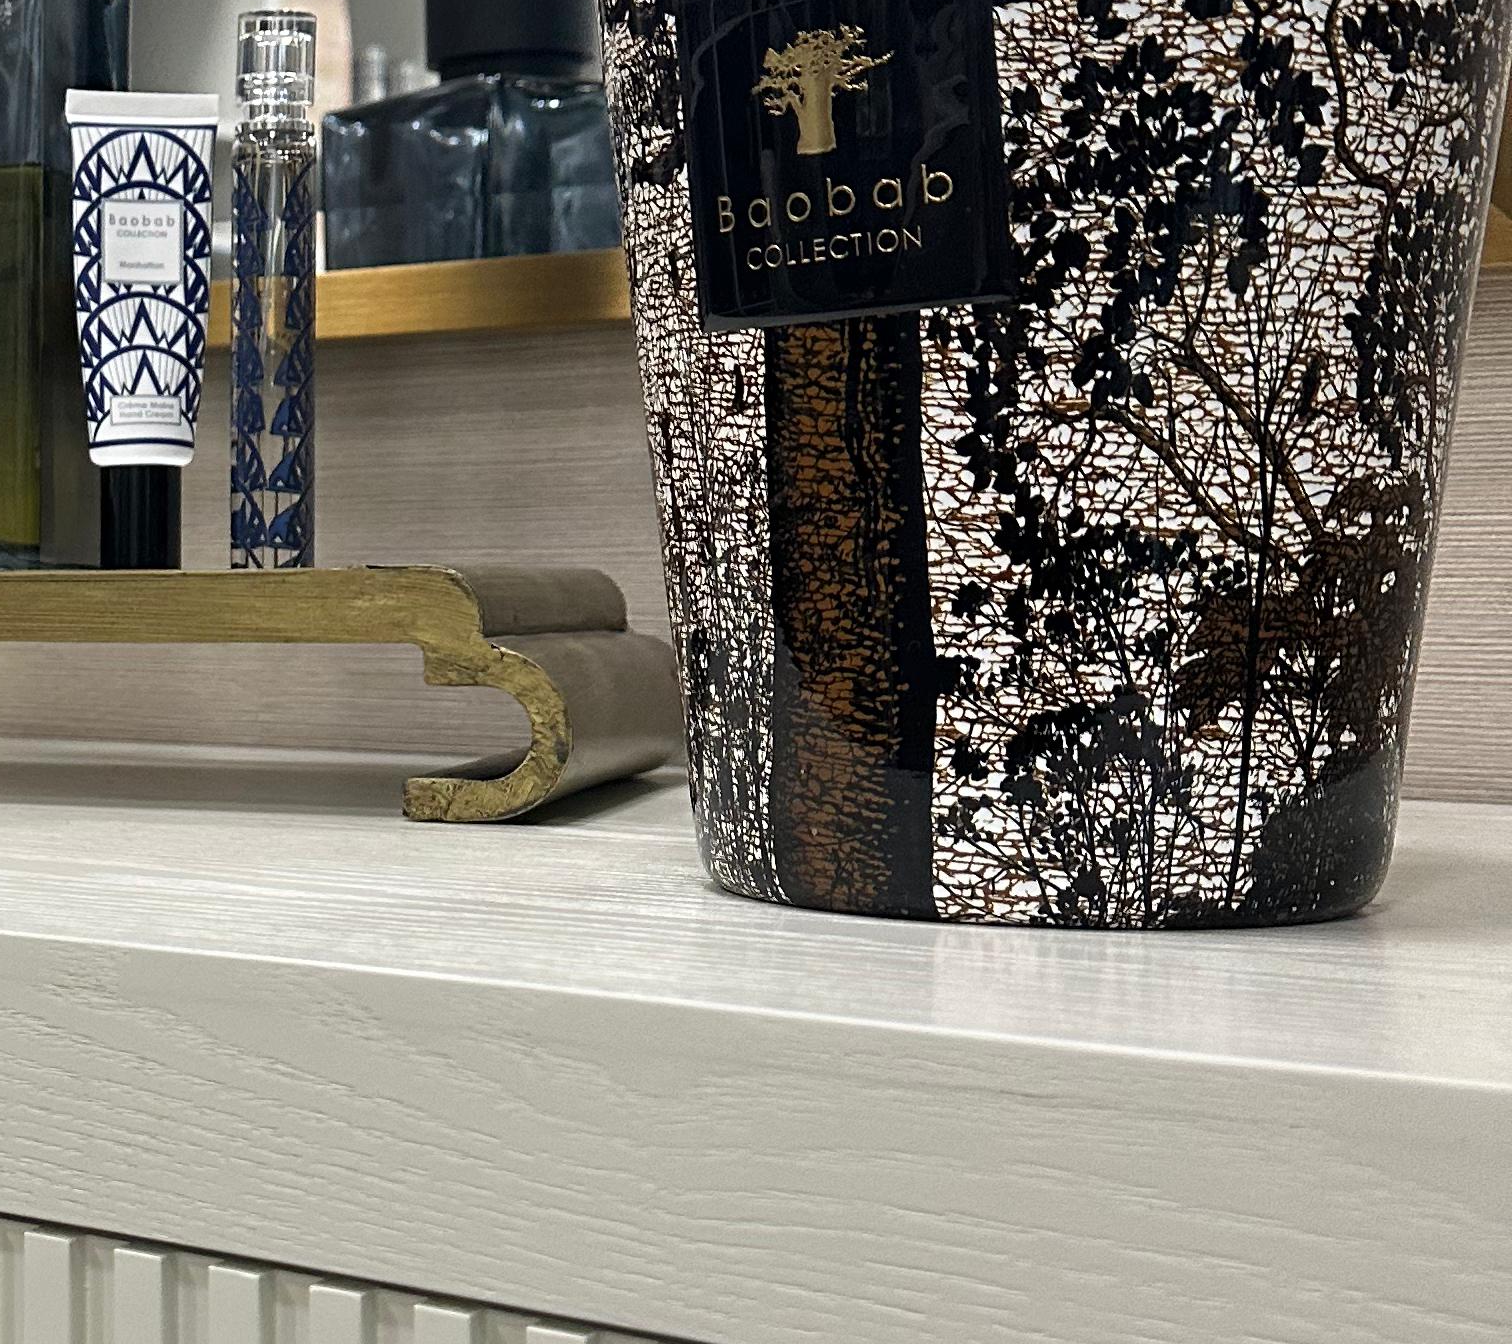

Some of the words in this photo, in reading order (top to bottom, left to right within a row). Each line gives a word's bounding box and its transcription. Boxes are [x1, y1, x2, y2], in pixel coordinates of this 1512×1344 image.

[108, 213, 176, 227] Baobab
[717, 163, 954, 233] Baobab
[746, 225, 923, 271] COLLECTION
